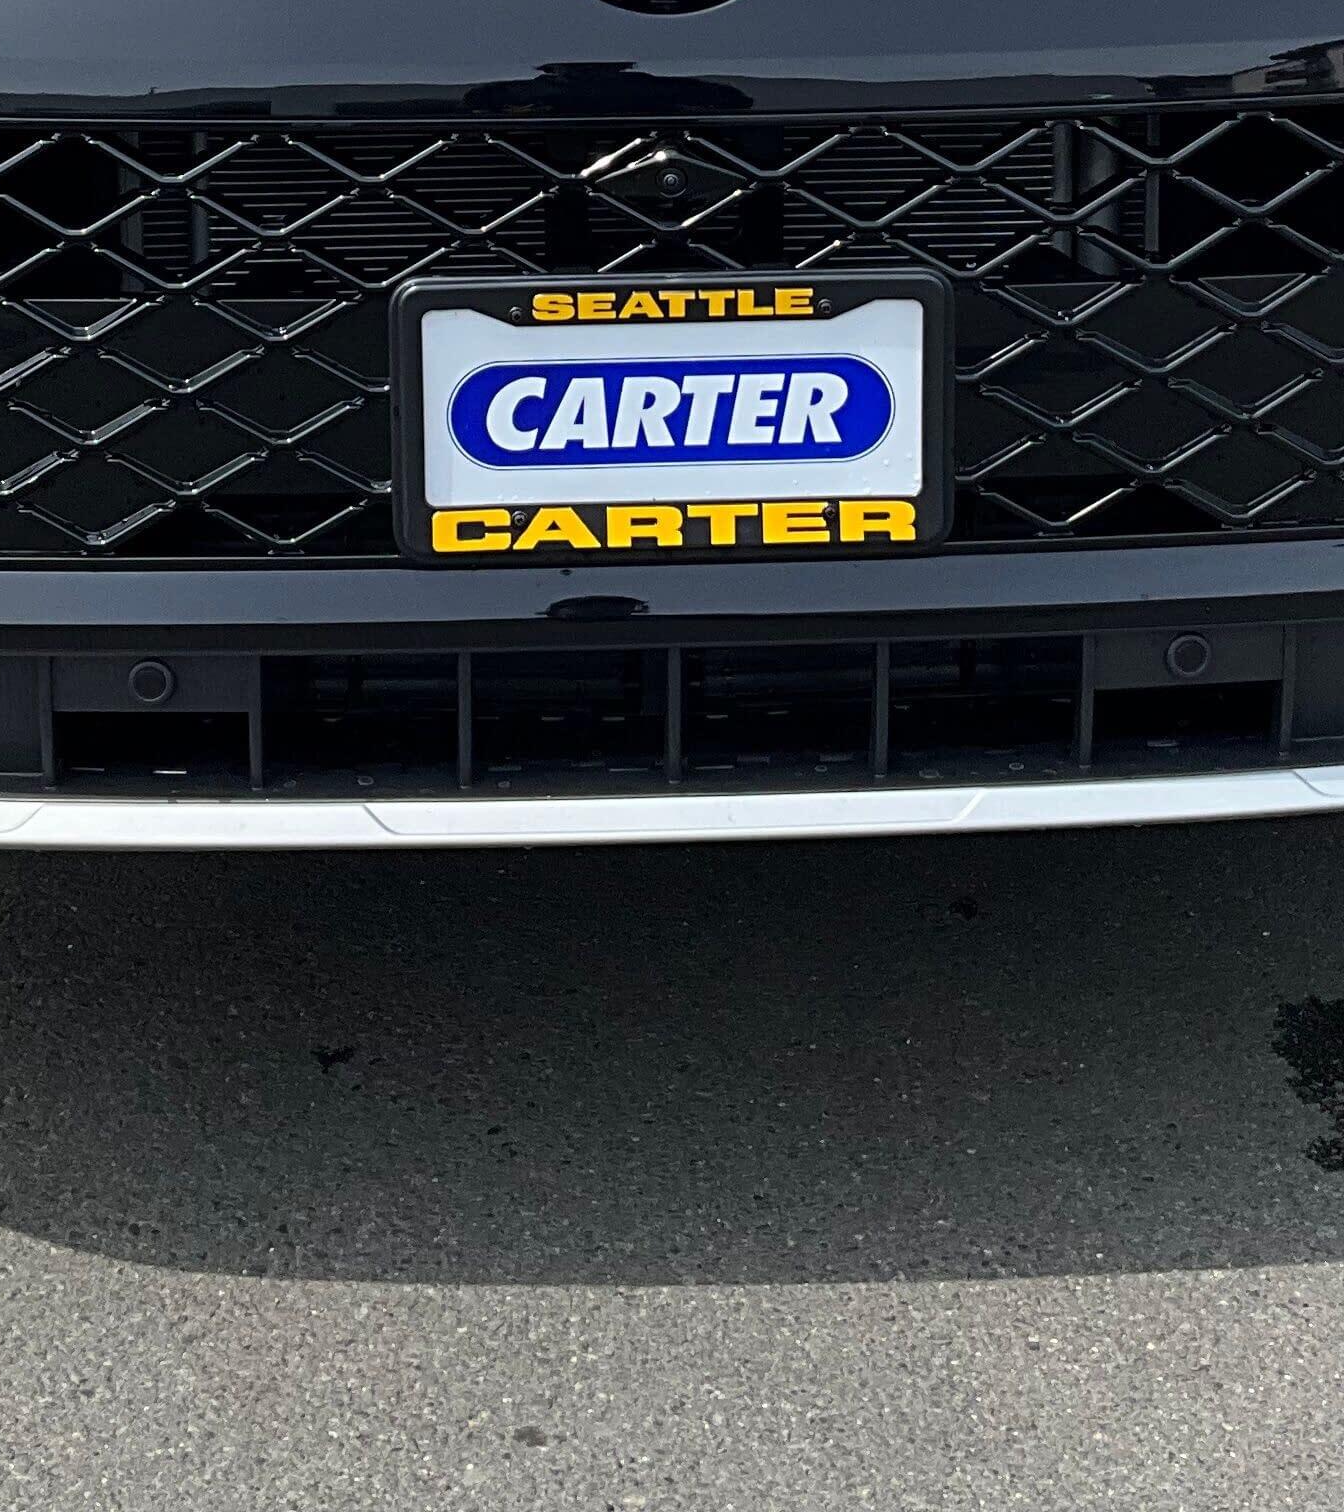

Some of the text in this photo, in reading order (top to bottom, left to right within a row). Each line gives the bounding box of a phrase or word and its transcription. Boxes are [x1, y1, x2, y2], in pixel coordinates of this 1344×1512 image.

[531, 287, 814, 321] SEATTLE
[485, 371, 849, 452] CARTER
[431, 499, 917, 553] CARTER
